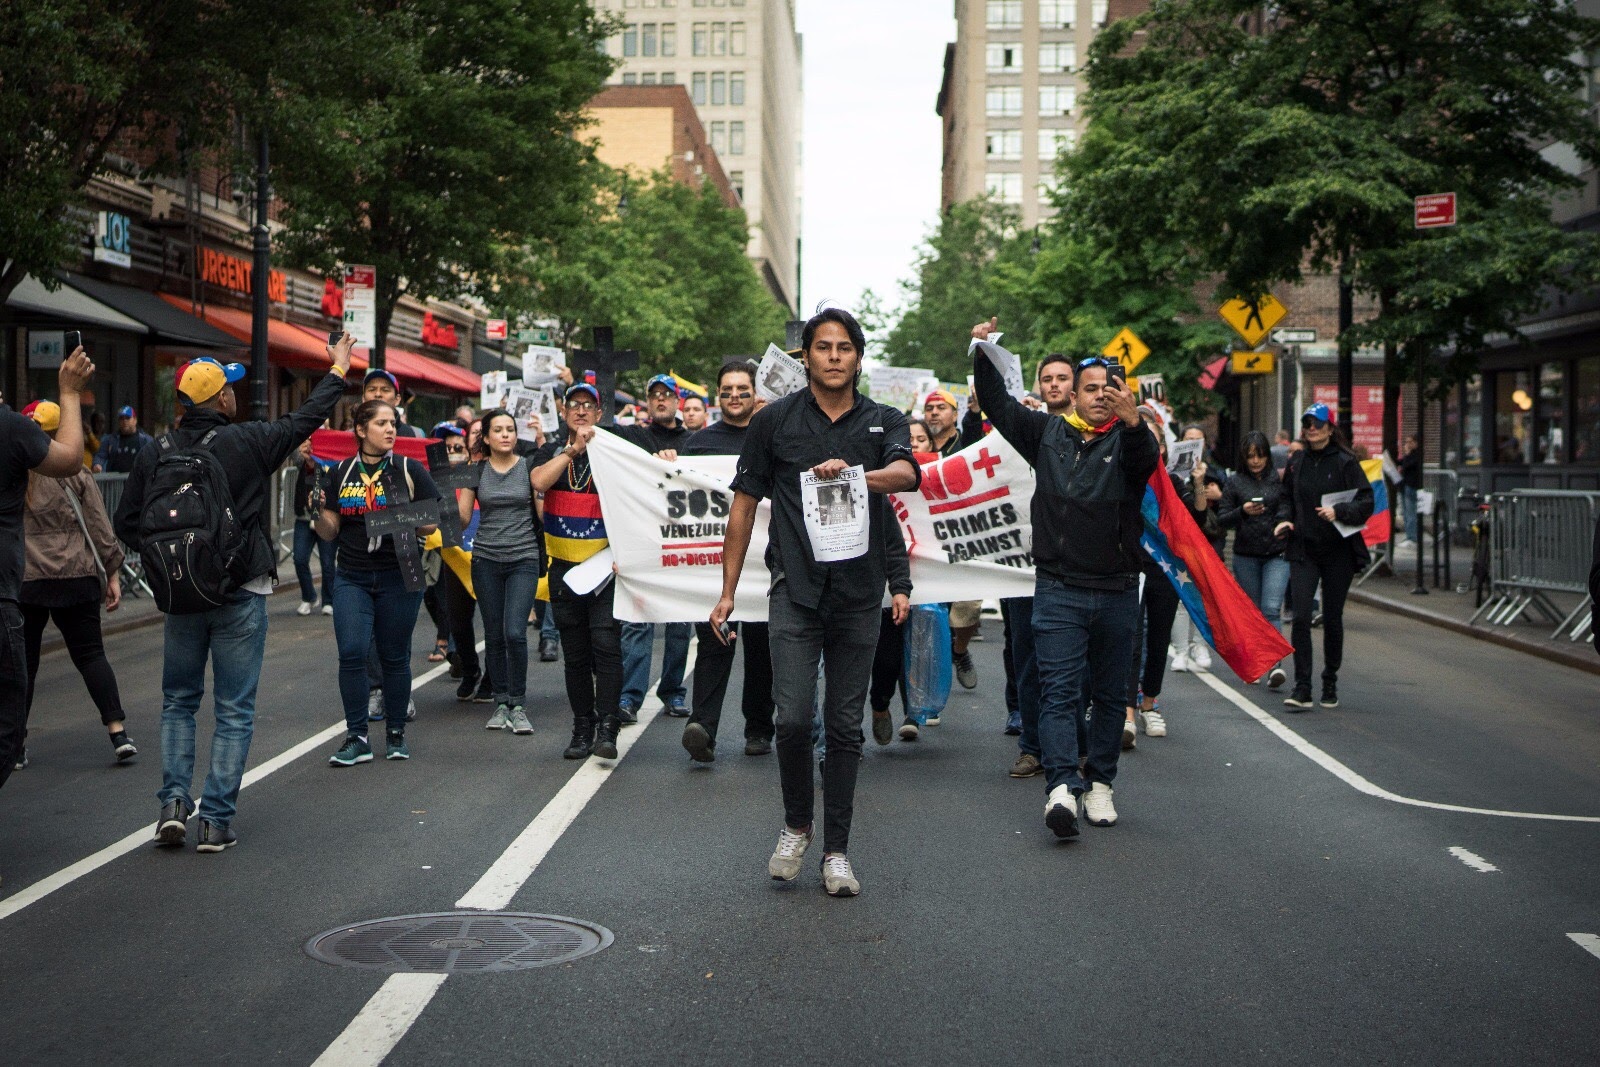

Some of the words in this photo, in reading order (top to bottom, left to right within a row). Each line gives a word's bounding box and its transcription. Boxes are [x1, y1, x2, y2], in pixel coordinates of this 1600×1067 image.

[102, 211, 131, 254] JOE
[196, 245, 252, 294] URGENT
[268, 269, 287, 304] ARE
[1141, 381, 1164, 405] NO
[667, 489, 730, 519] SOS
[932, 502, 1018, 541] CRIMES
[660, 523, 726, 538] VENEZUEL
[942, 528, 1022, 564] AGAINST
